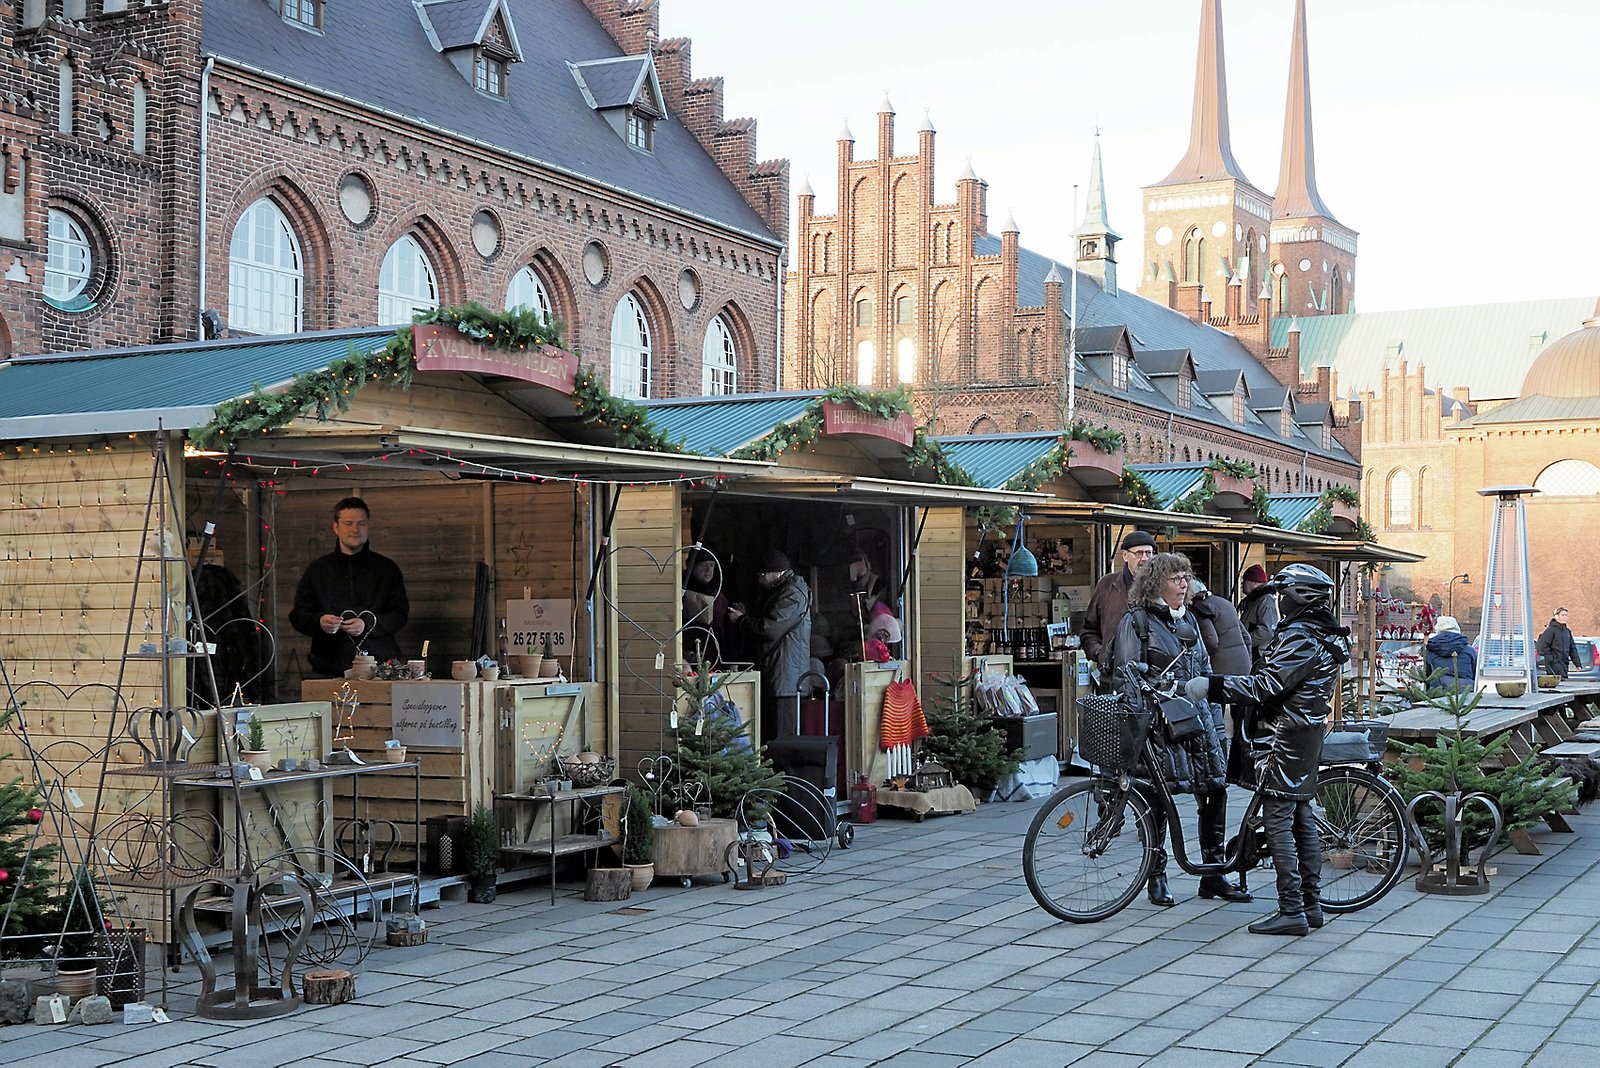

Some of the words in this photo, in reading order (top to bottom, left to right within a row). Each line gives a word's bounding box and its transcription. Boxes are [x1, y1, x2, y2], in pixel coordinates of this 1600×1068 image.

[513, 631, 524, 646] 26
[526, 631, 537, 646] 27
[553, 631, 565, 646] 36
